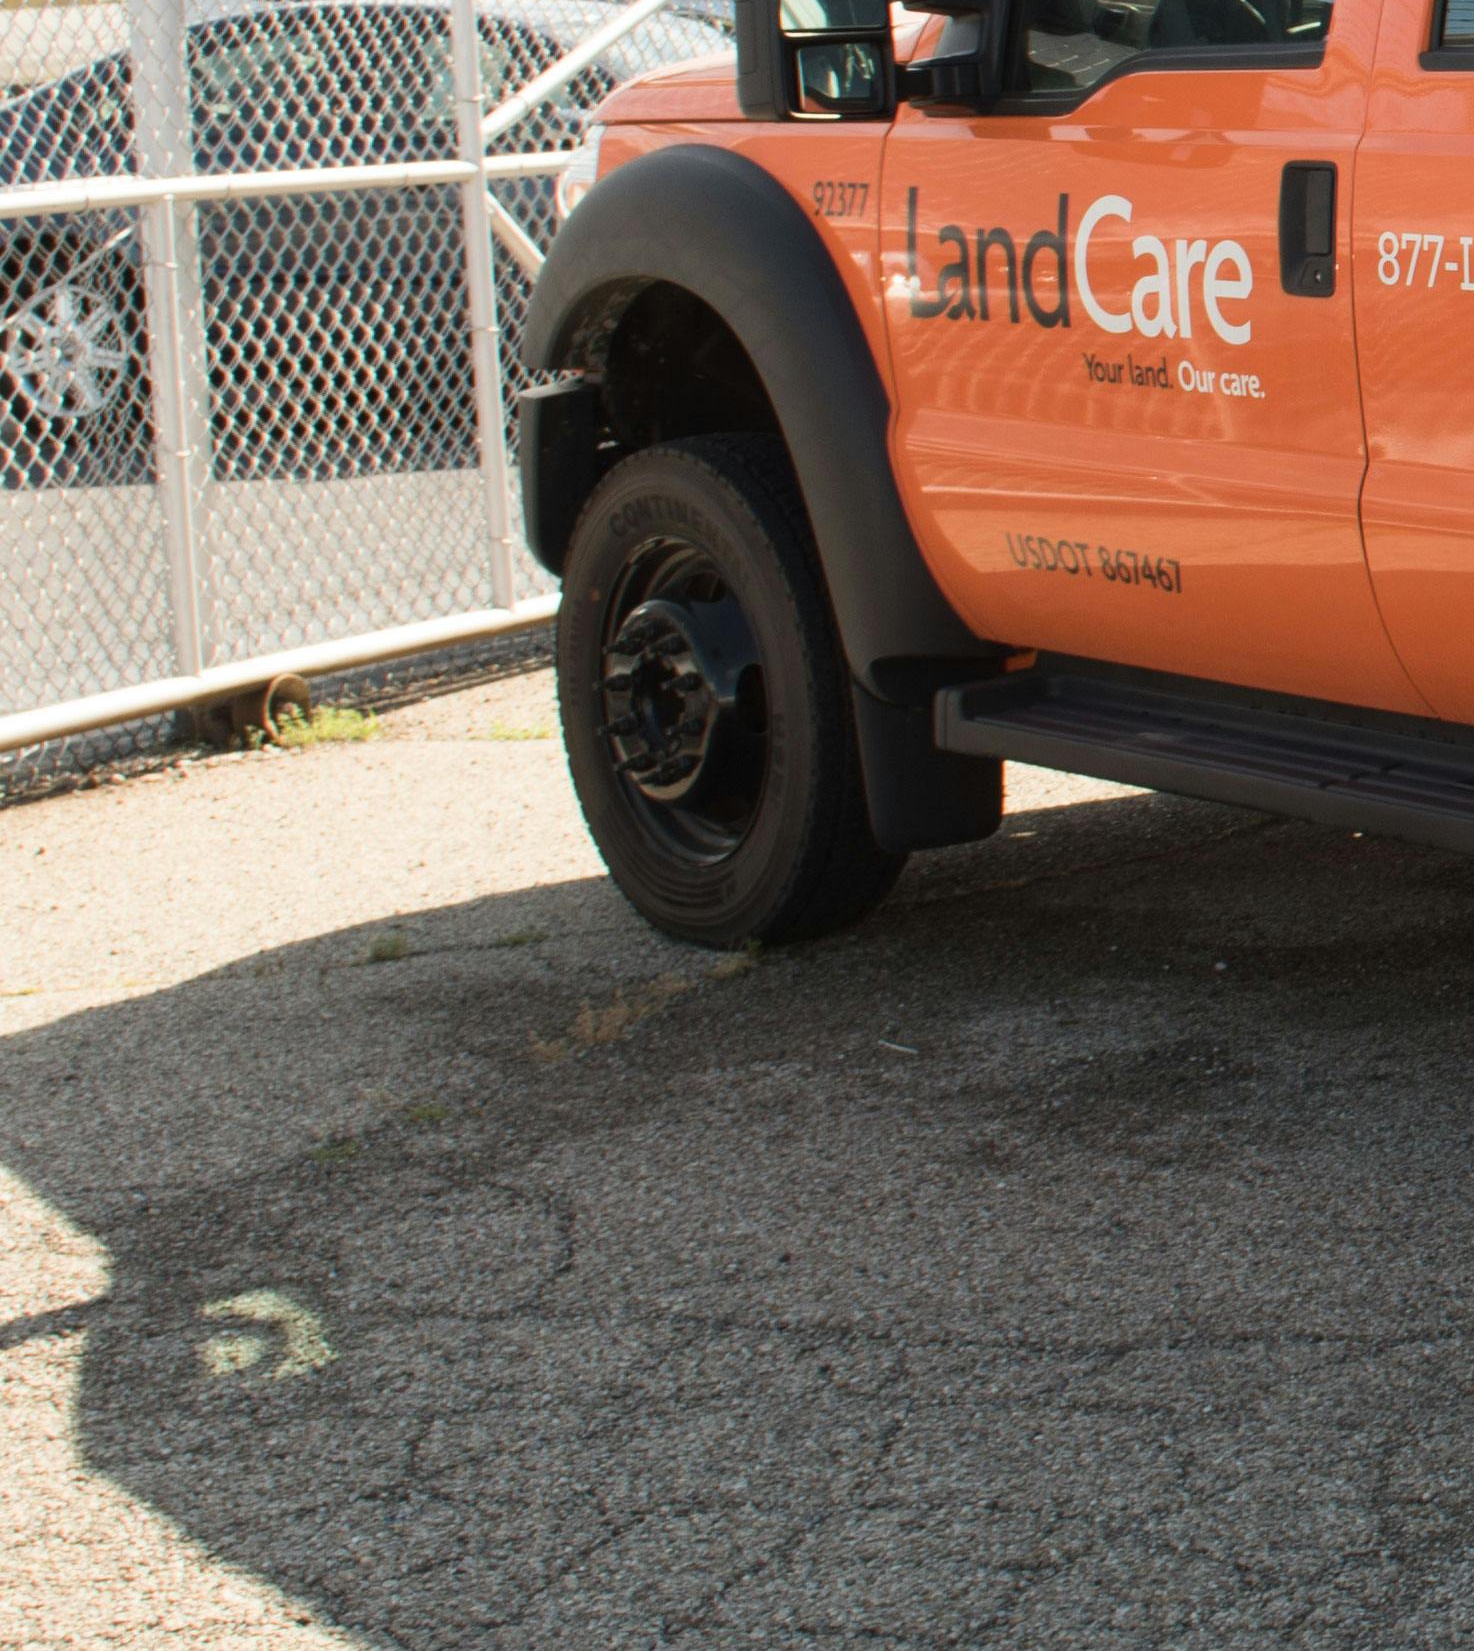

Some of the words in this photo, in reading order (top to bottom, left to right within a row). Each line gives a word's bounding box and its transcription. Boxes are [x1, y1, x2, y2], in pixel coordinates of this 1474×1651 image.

[812, 180, 870, 218] 92377
[907, 185, 1254, 346] LandCare
[1083, 352, 1124, 384] Your
[1127, 352, 1174, 389] land.
[1177, 359, 1216, 394] Our
[1219, 371, 1266, 399] care.
[1005, 531, 1093, 577] USDOT
[1097, 545, 1183, 594] 867467
